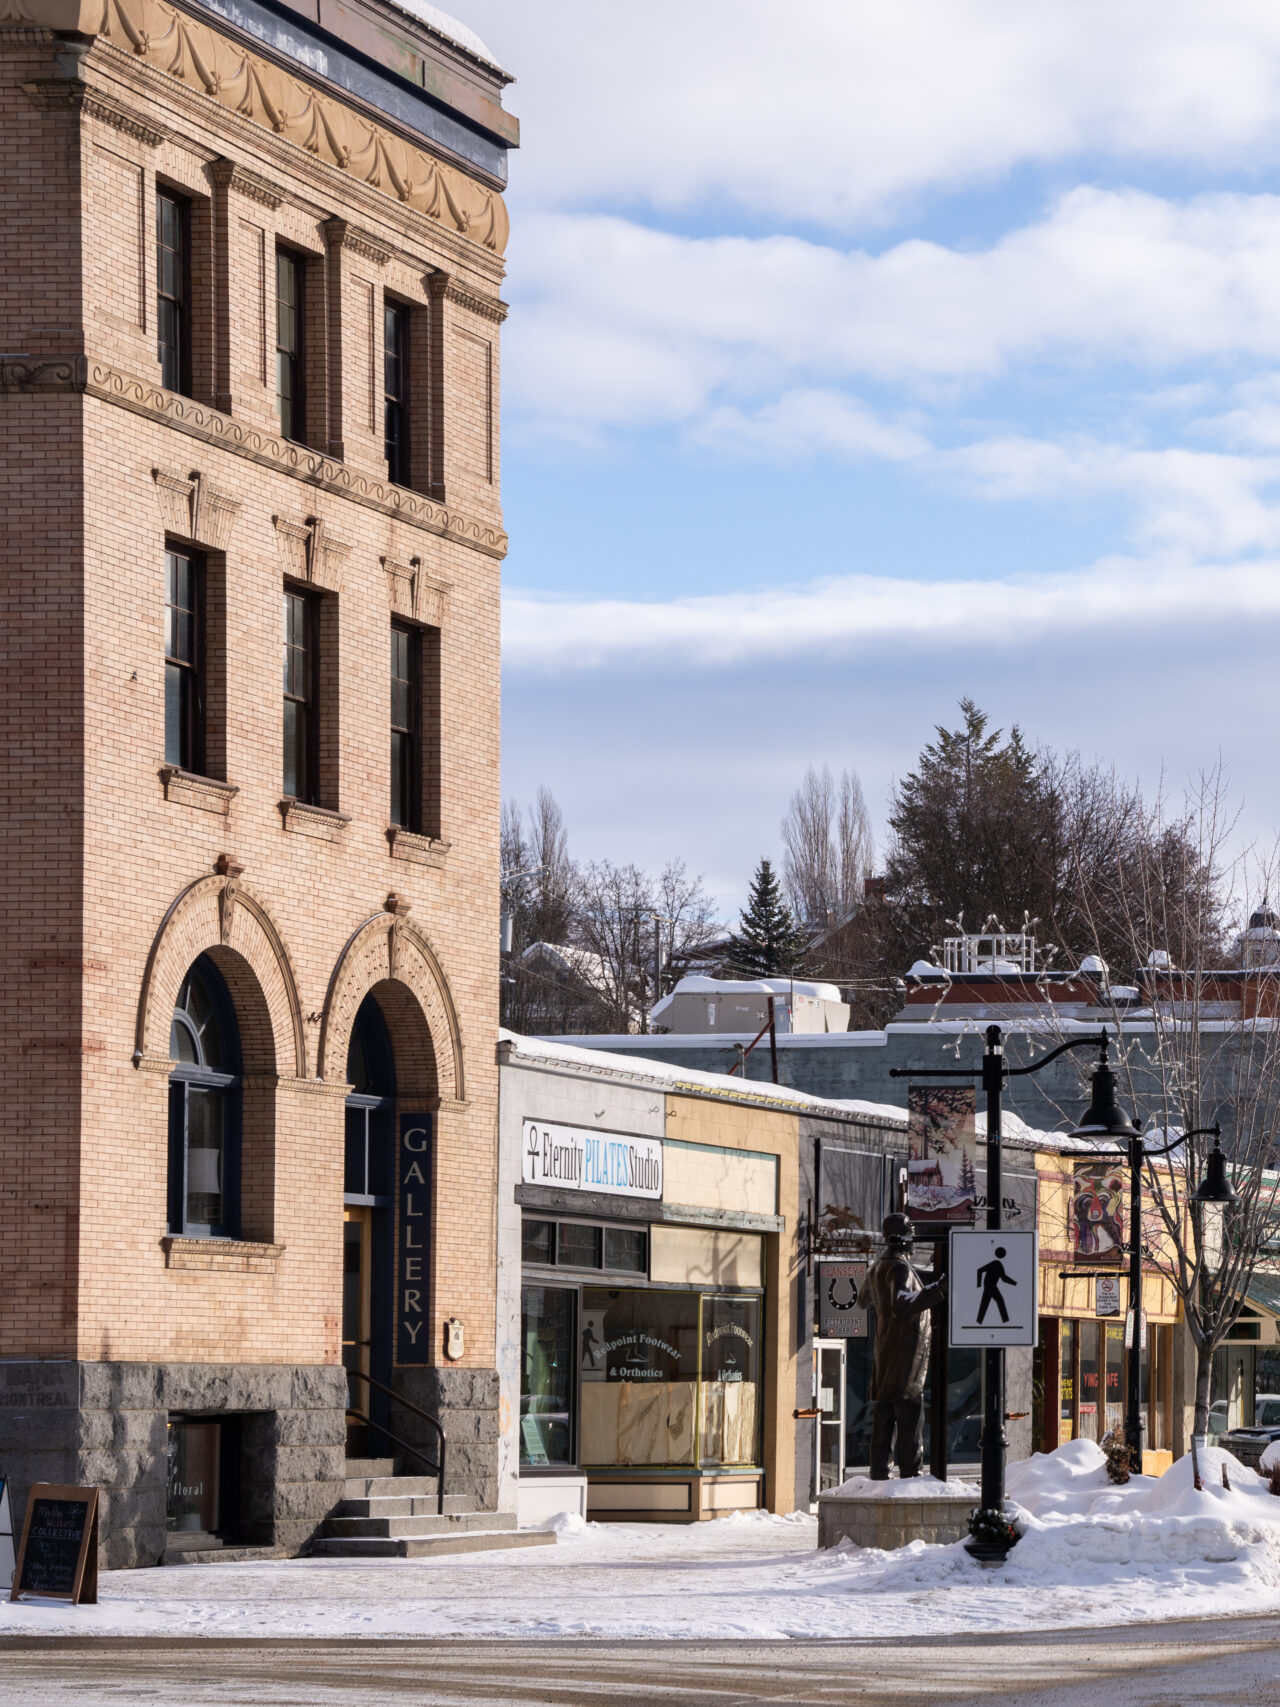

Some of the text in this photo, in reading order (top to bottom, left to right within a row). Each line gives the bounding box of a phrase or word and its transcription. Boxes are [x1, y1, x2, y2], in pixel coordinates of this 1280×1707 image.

[542, 1131, 660, 1190] Eternity PILATES Studio
[403, 1127, 428, 1345] GALLERY
[593, 1333, 682, 1360] Redpoint Footwear
[609, 1366, 664, 1378] & Orthotics
[173, 1481, 203, 1496] floral
[32, 1527, 82, 1539] COLLECTIVE
